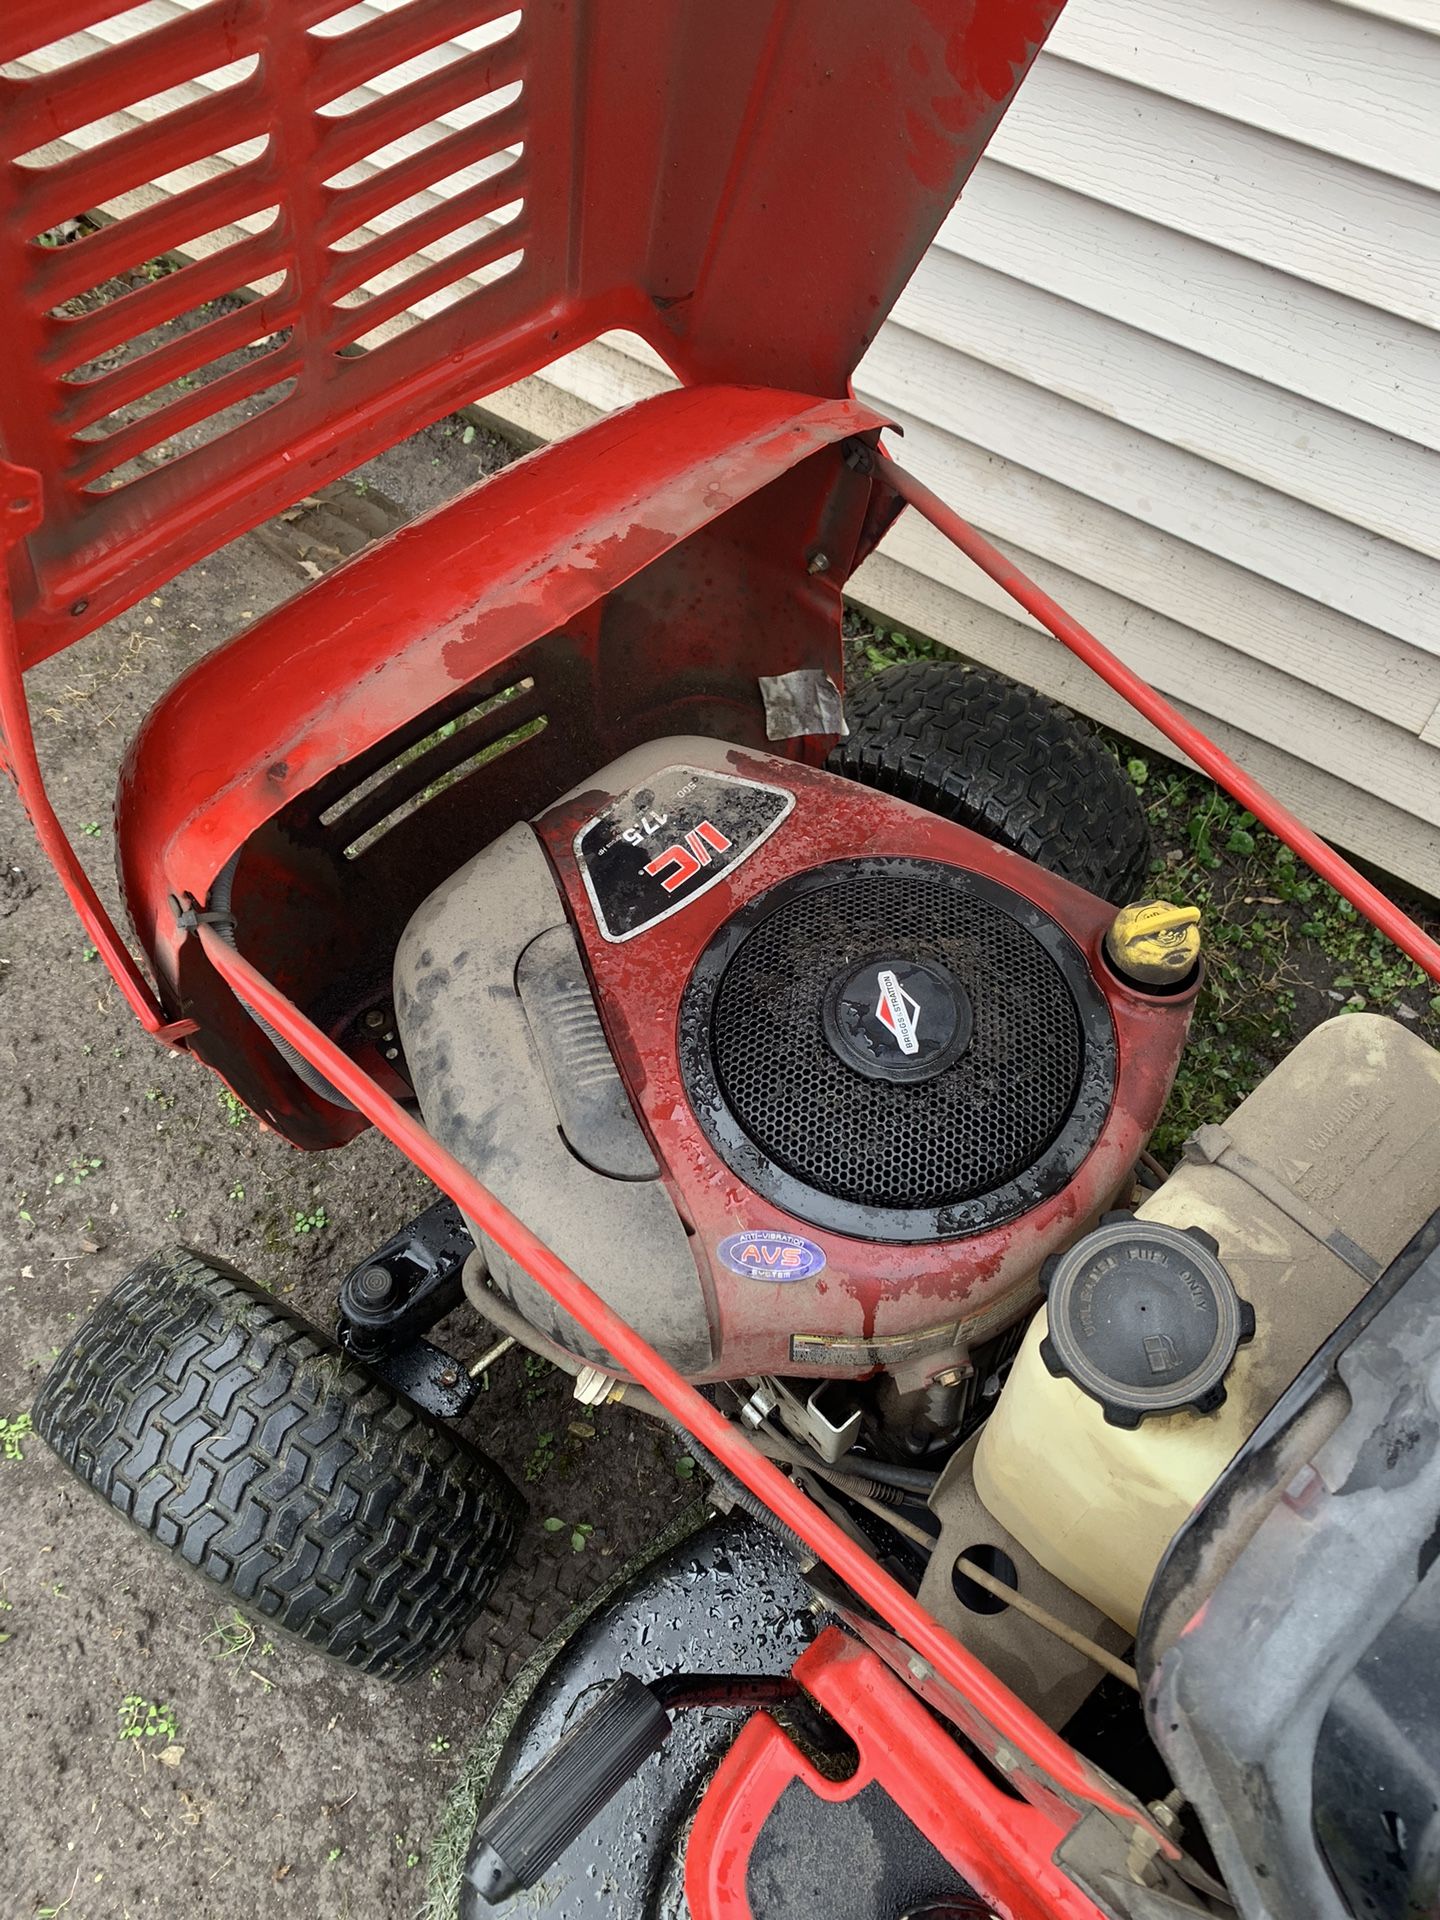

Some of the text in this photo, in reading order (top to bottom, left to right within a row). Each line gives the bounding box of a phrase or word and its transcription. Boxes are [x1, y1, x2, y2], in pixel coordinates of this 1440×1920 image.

[676, 781, 697, 799] 500
[623, 810, 668, 847] 17.5
[1303, 1090, 1370, 1154] WARNING
[741, 1243, 802, 1267] AVS
[1125, 1248, 1171, 1268] FUEL
[1178, 1269, 1208, 1313] ONLY
